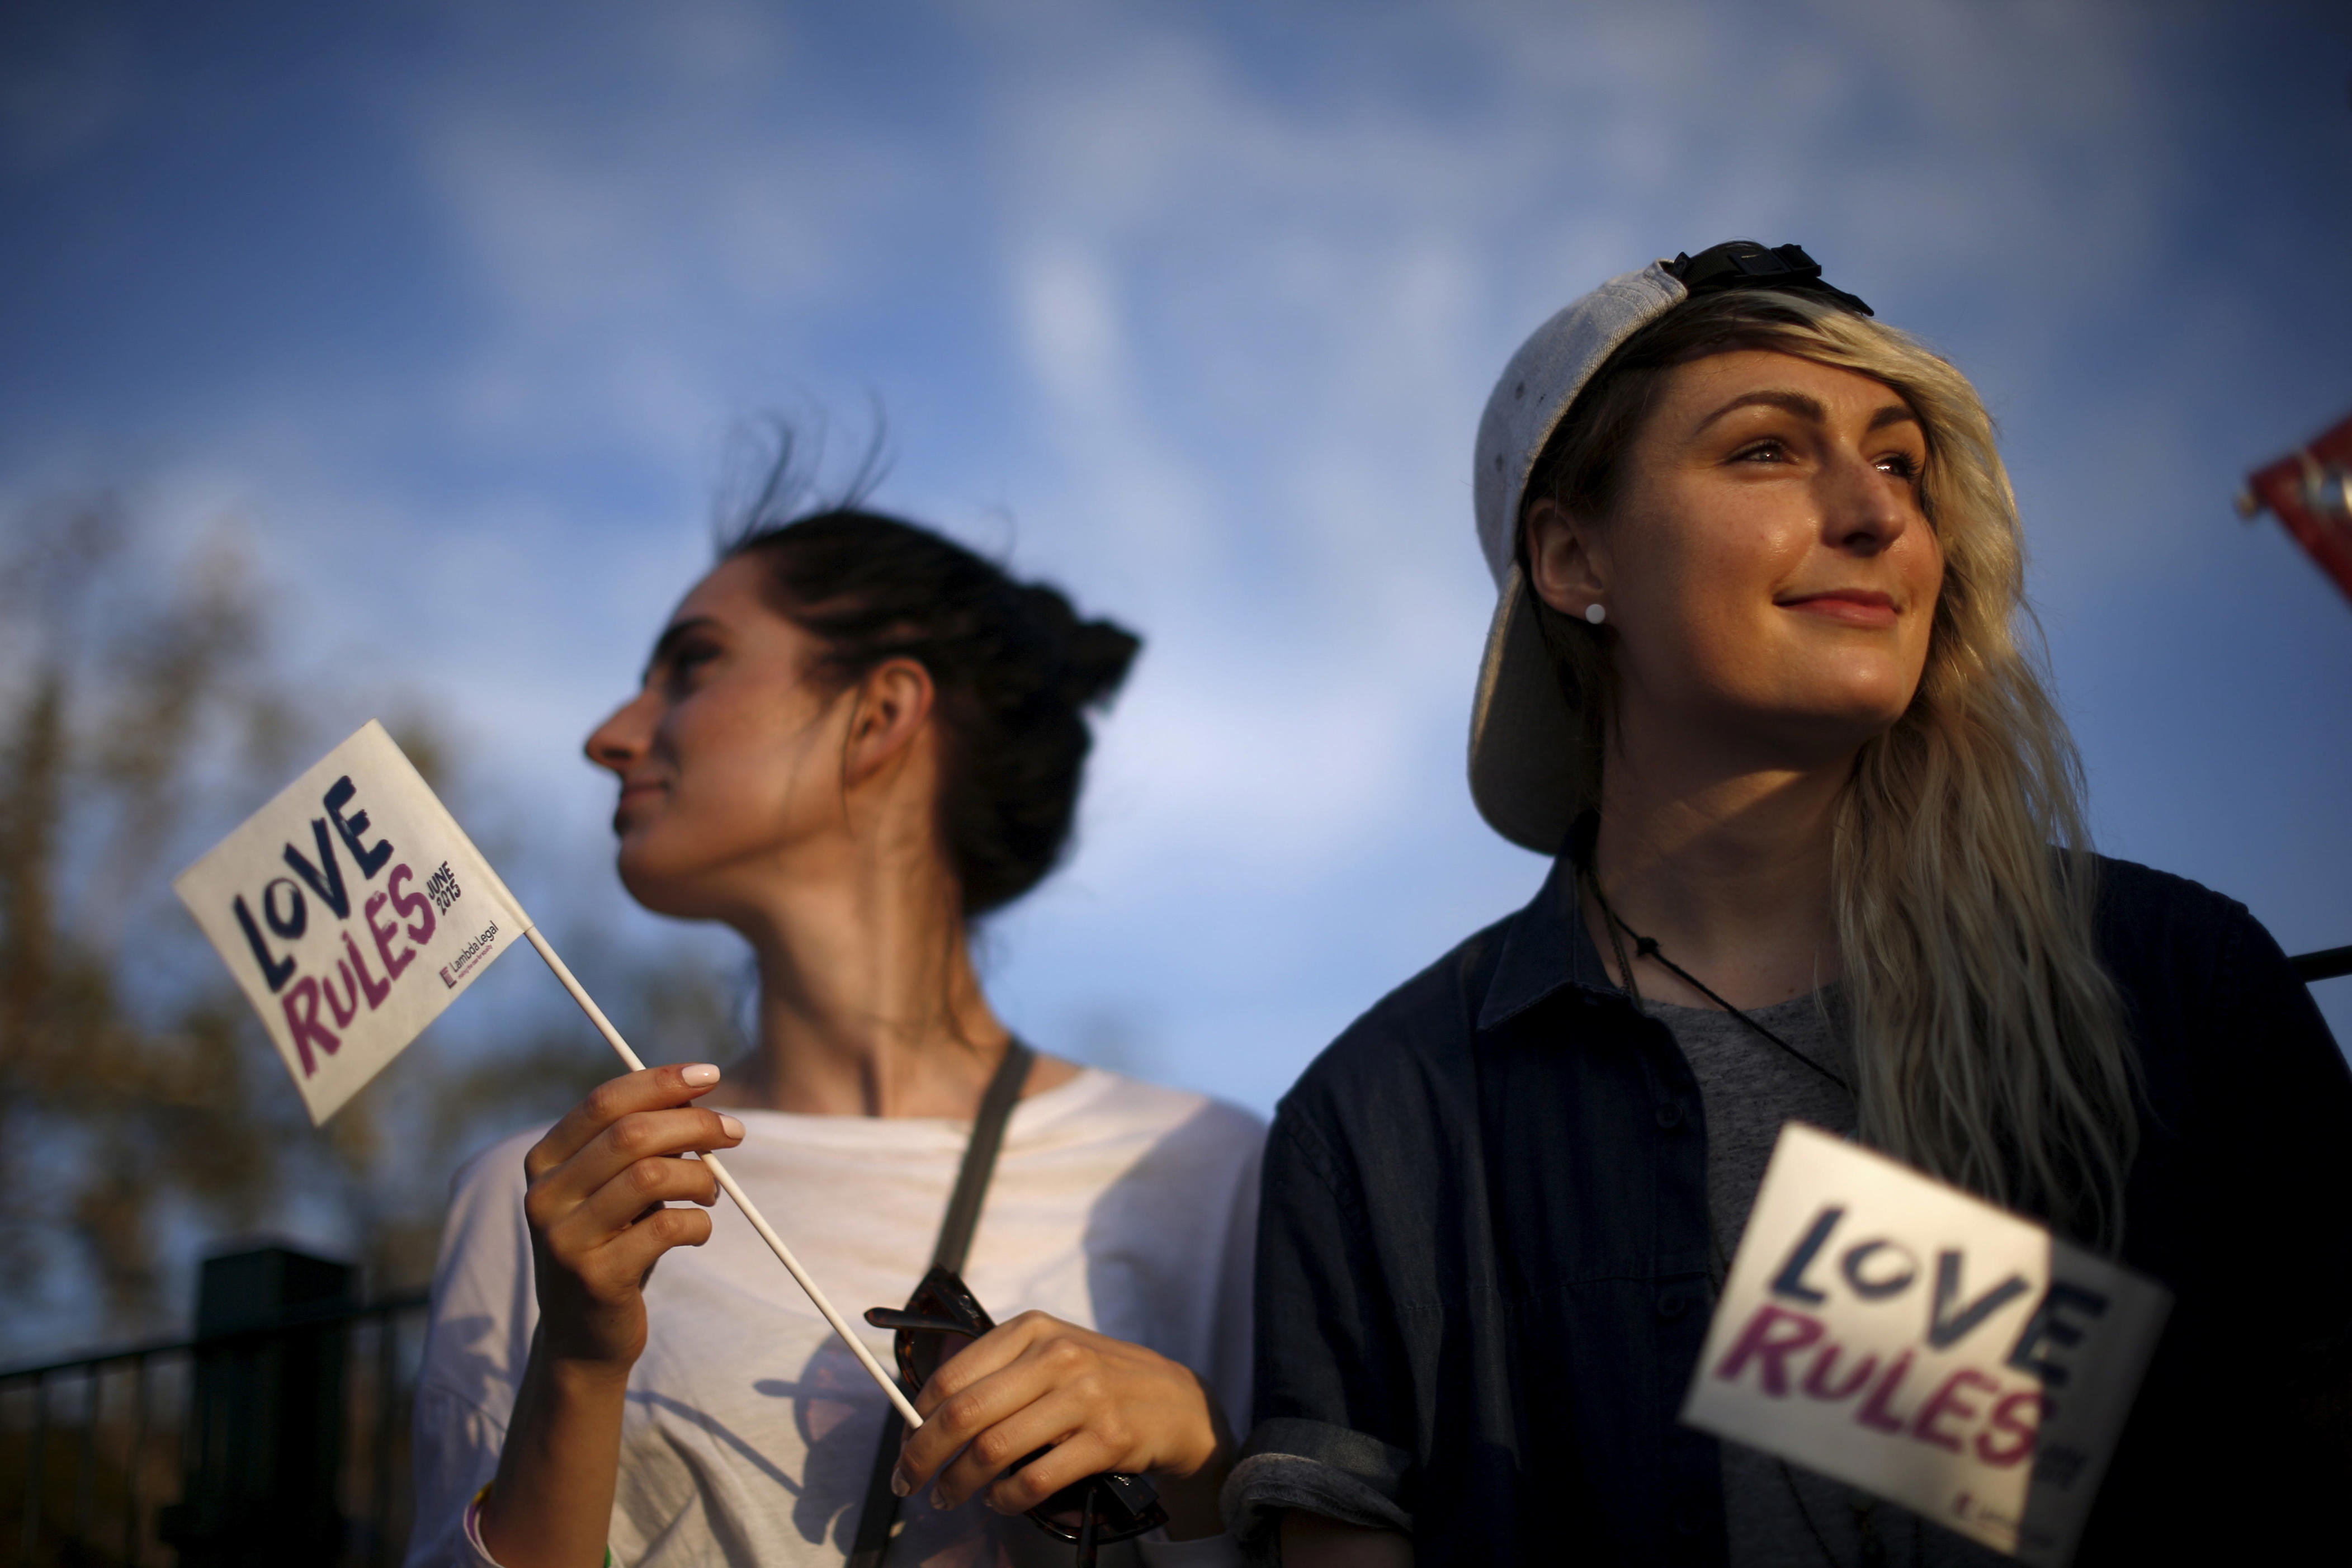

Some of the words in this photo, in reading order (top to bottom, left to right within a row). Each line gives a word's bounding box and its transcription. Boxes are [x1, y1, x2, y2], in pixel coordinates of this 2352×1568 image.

[232, 774, 394, 994] LOVE
[427, 860, 455, 900] JUNE
[437, 878, 461, 917] 2015
[448, 941, 480, 972] Lambda
[474, 919, 499, 947] Legal
[282, 863, 436, 1080] RULES
[1766, 1201, 2110, 1390] LOVE
[1713, 1303, 2059, 1471] RULES
